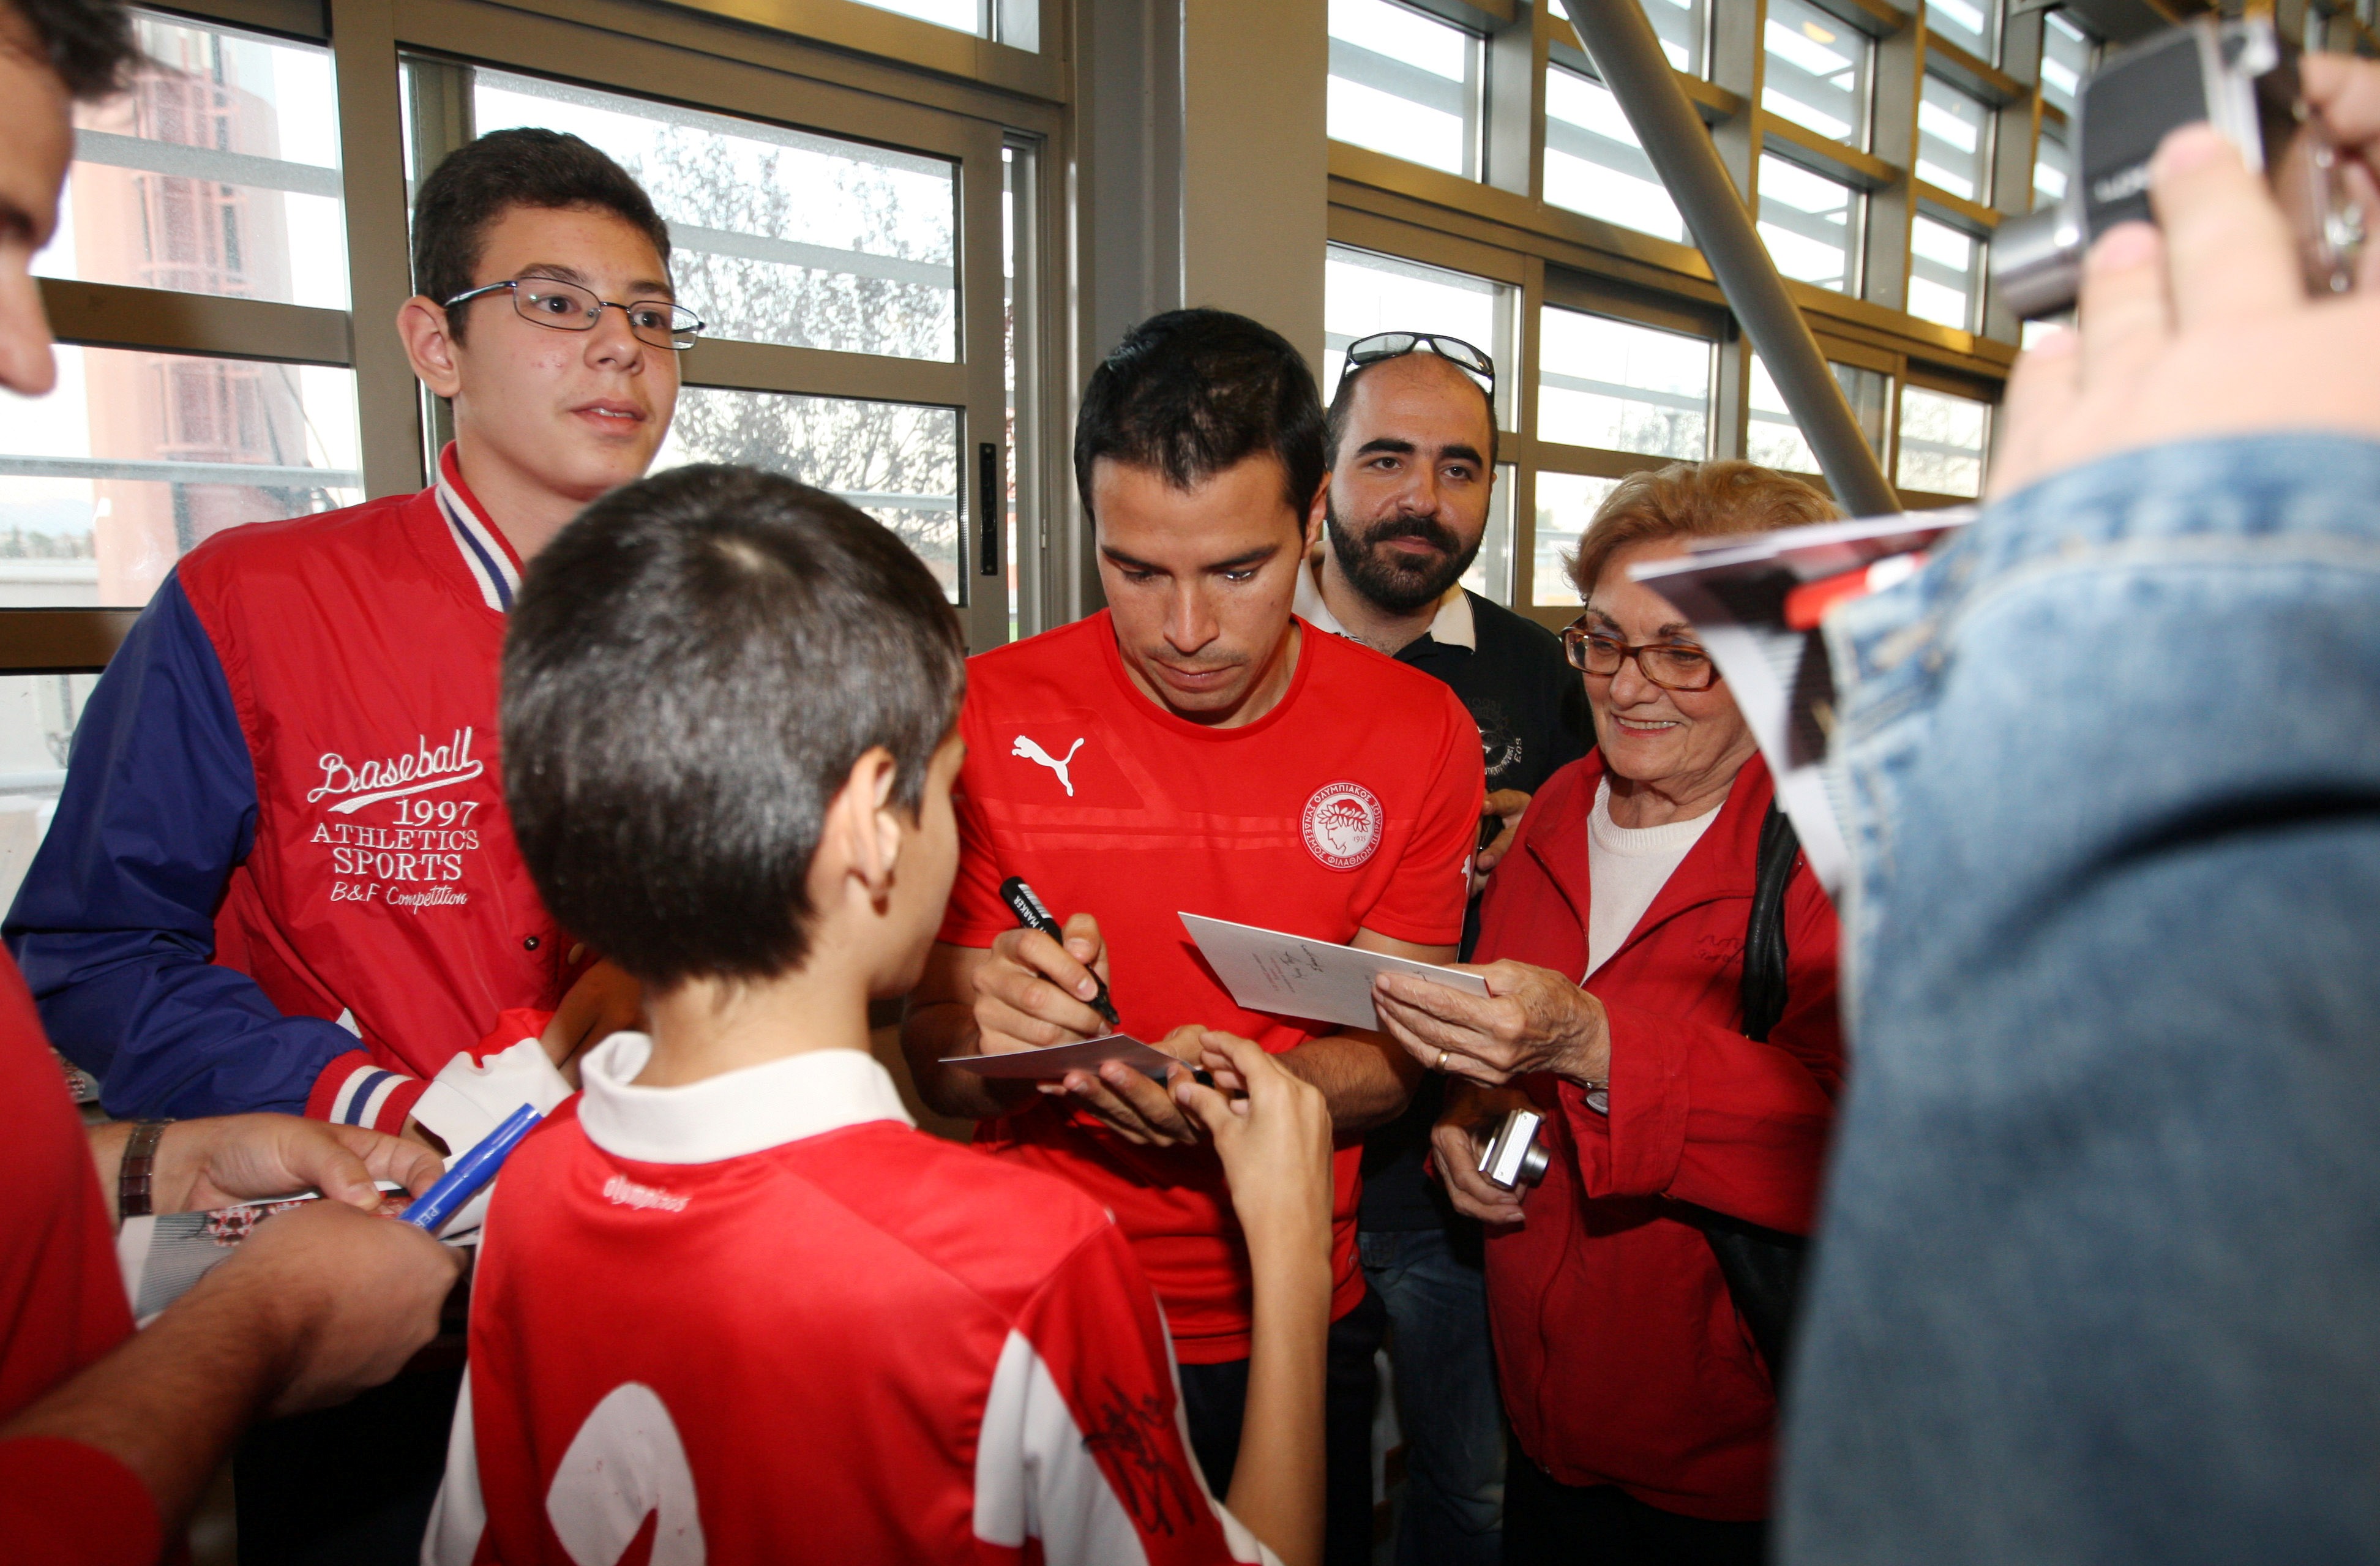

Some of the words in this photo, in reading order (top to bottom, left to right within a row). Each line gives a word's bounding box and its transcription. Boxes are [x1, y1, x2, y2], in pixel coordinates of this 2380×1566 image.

[307, 726, 482, 803] Baseball
[1314, 784, 1372, 803] ΟΛΥΜΠΙΑΚΟΣ
[392, 799, 479, 826] 1997
[310, 822, 480, 851] ATHLETICS
[1305, 804, 1326, 858] ΣΥΝΔΕΣΜΟΣ
[332, 847, 462, 882] SPORTS
[331, 882, 381, 902] B&F
[387, 885, 468, 915] Competition
[1014, 896, 1039, 928] MARKER
